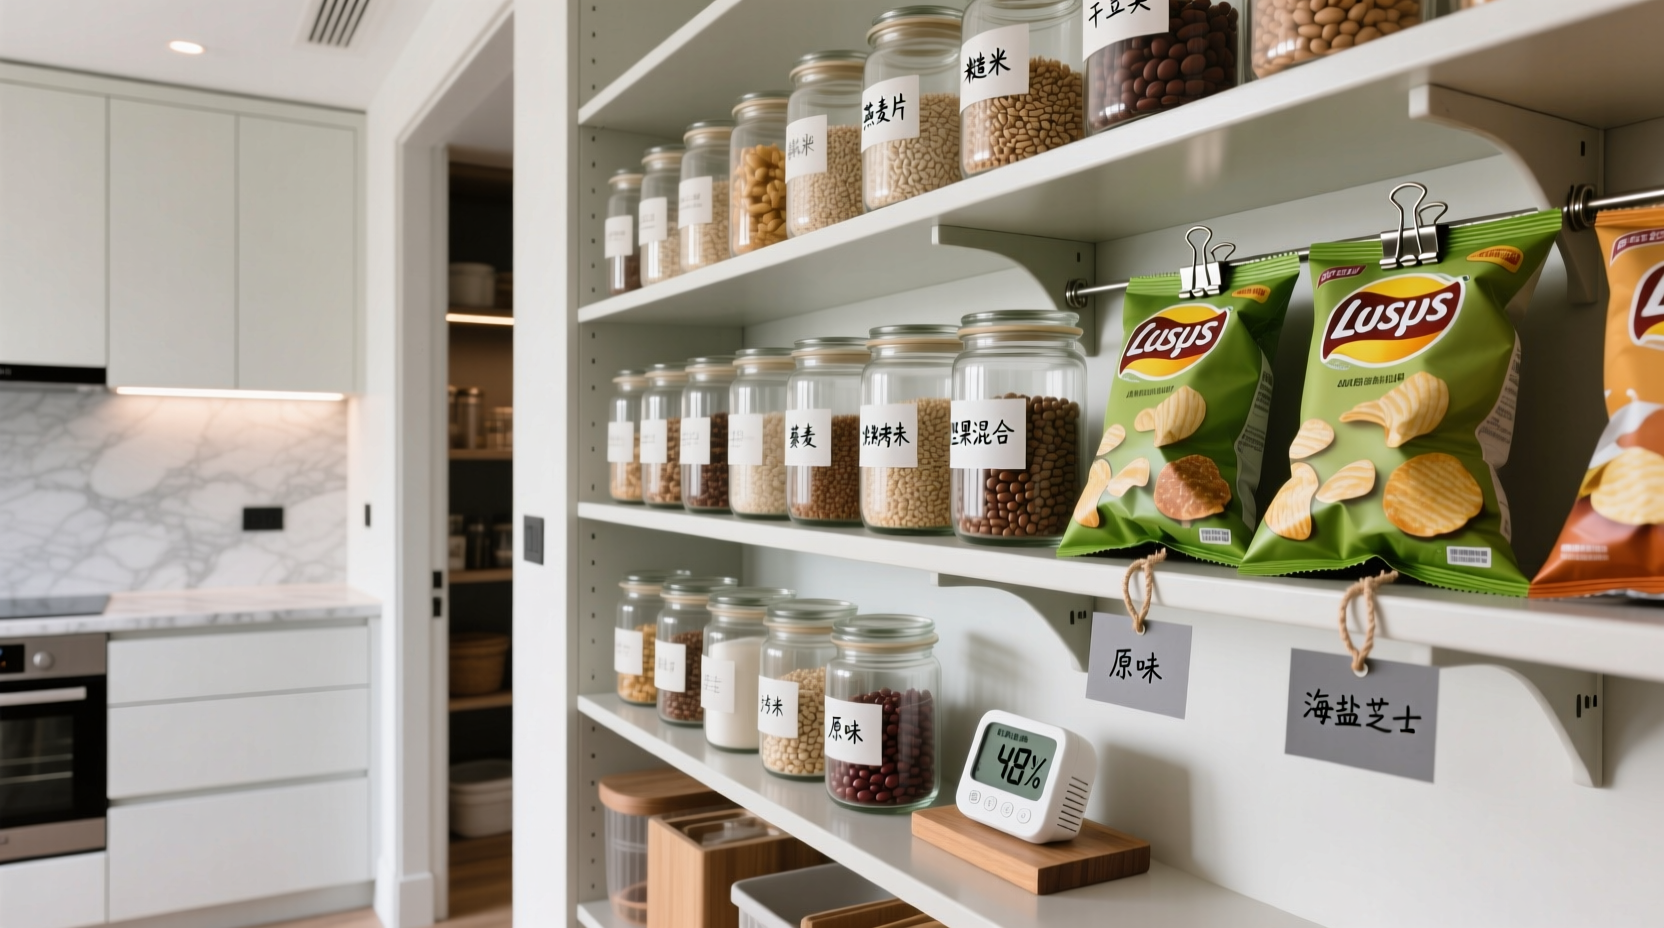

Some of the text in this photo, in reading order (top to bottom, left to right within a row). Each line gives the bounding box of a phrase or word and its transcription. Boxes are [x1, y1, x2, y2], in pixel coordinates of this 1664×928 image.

[963, 47, 1011, 84] 糙米
[1109, 648, 1163, 684] 原味
[1303, 688, 1422, 734] 海盐芝士
[828, 716, 864, 744] 原味
[997, 743, 1047, 789] 48%
